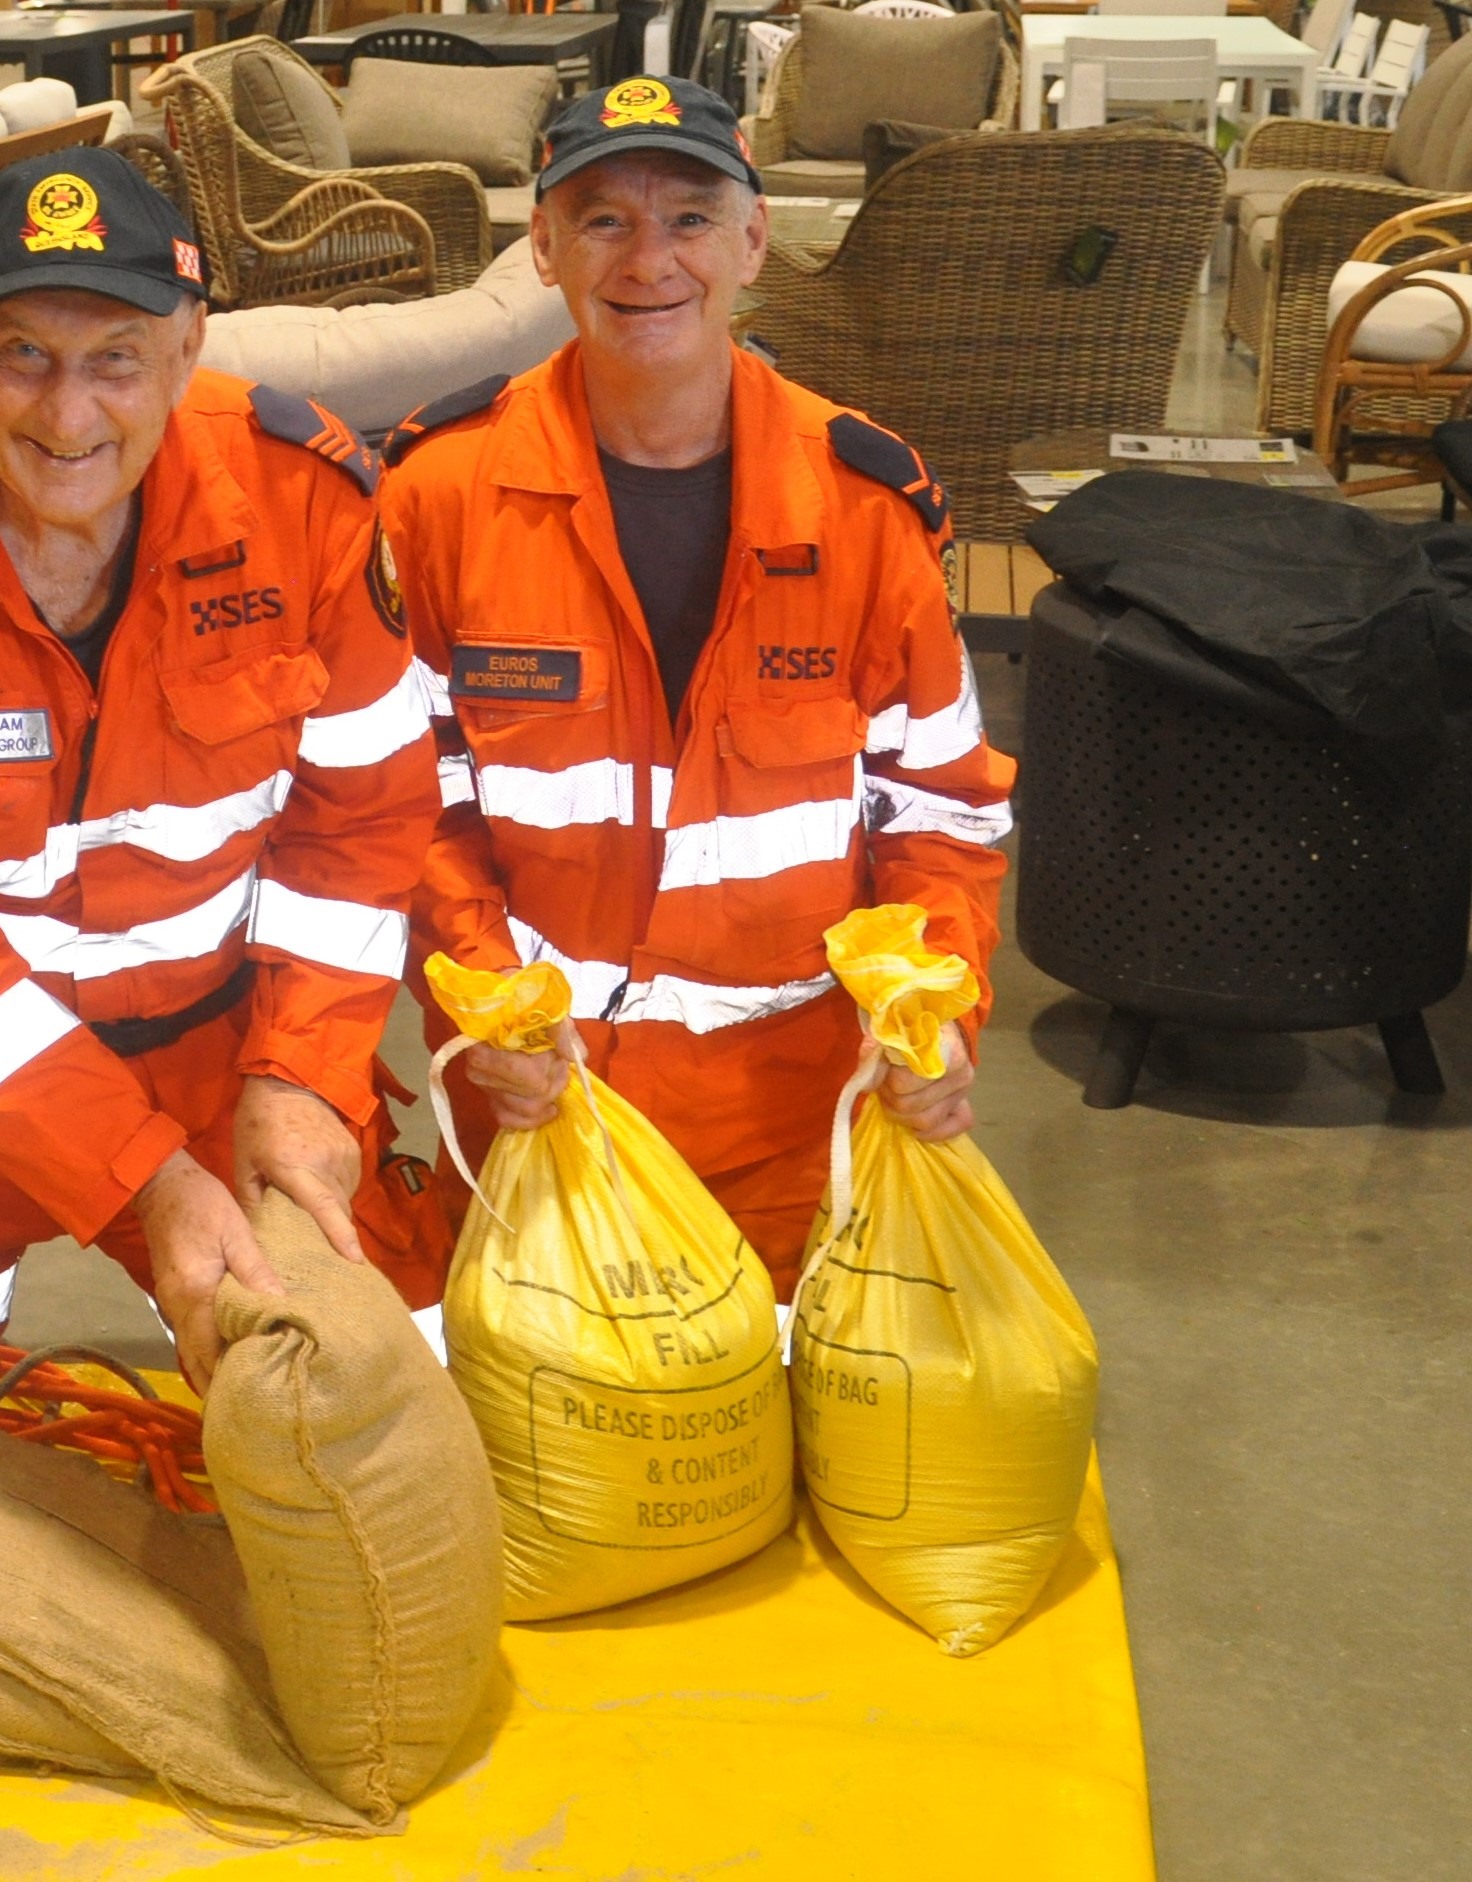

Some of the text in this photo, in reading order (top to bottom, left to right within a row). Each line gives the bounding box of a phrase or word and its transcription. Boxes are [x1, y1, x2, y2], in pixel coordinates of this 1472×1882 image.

[219, 587, 285, 628] SES
[464, 672, 563, 690] MORETON UNIT
[489, 656, 539, 672] EUROS
[786, 647, 838, 680] SES
[653, 1329, 730, 1367] FILL
[817, 1367, 835, 1397] OF
[838, 1373, 879, 1406] BAG
[564, 1397, 655, 1441] PLEASE
[661, 1398, 749, 1441] DISPOSE
[646, 1458, 664, 1485] &
[671, 1434, 760, 1485] CONTENT
[637, 1473, 769, 1528] RESPONSIBLY
